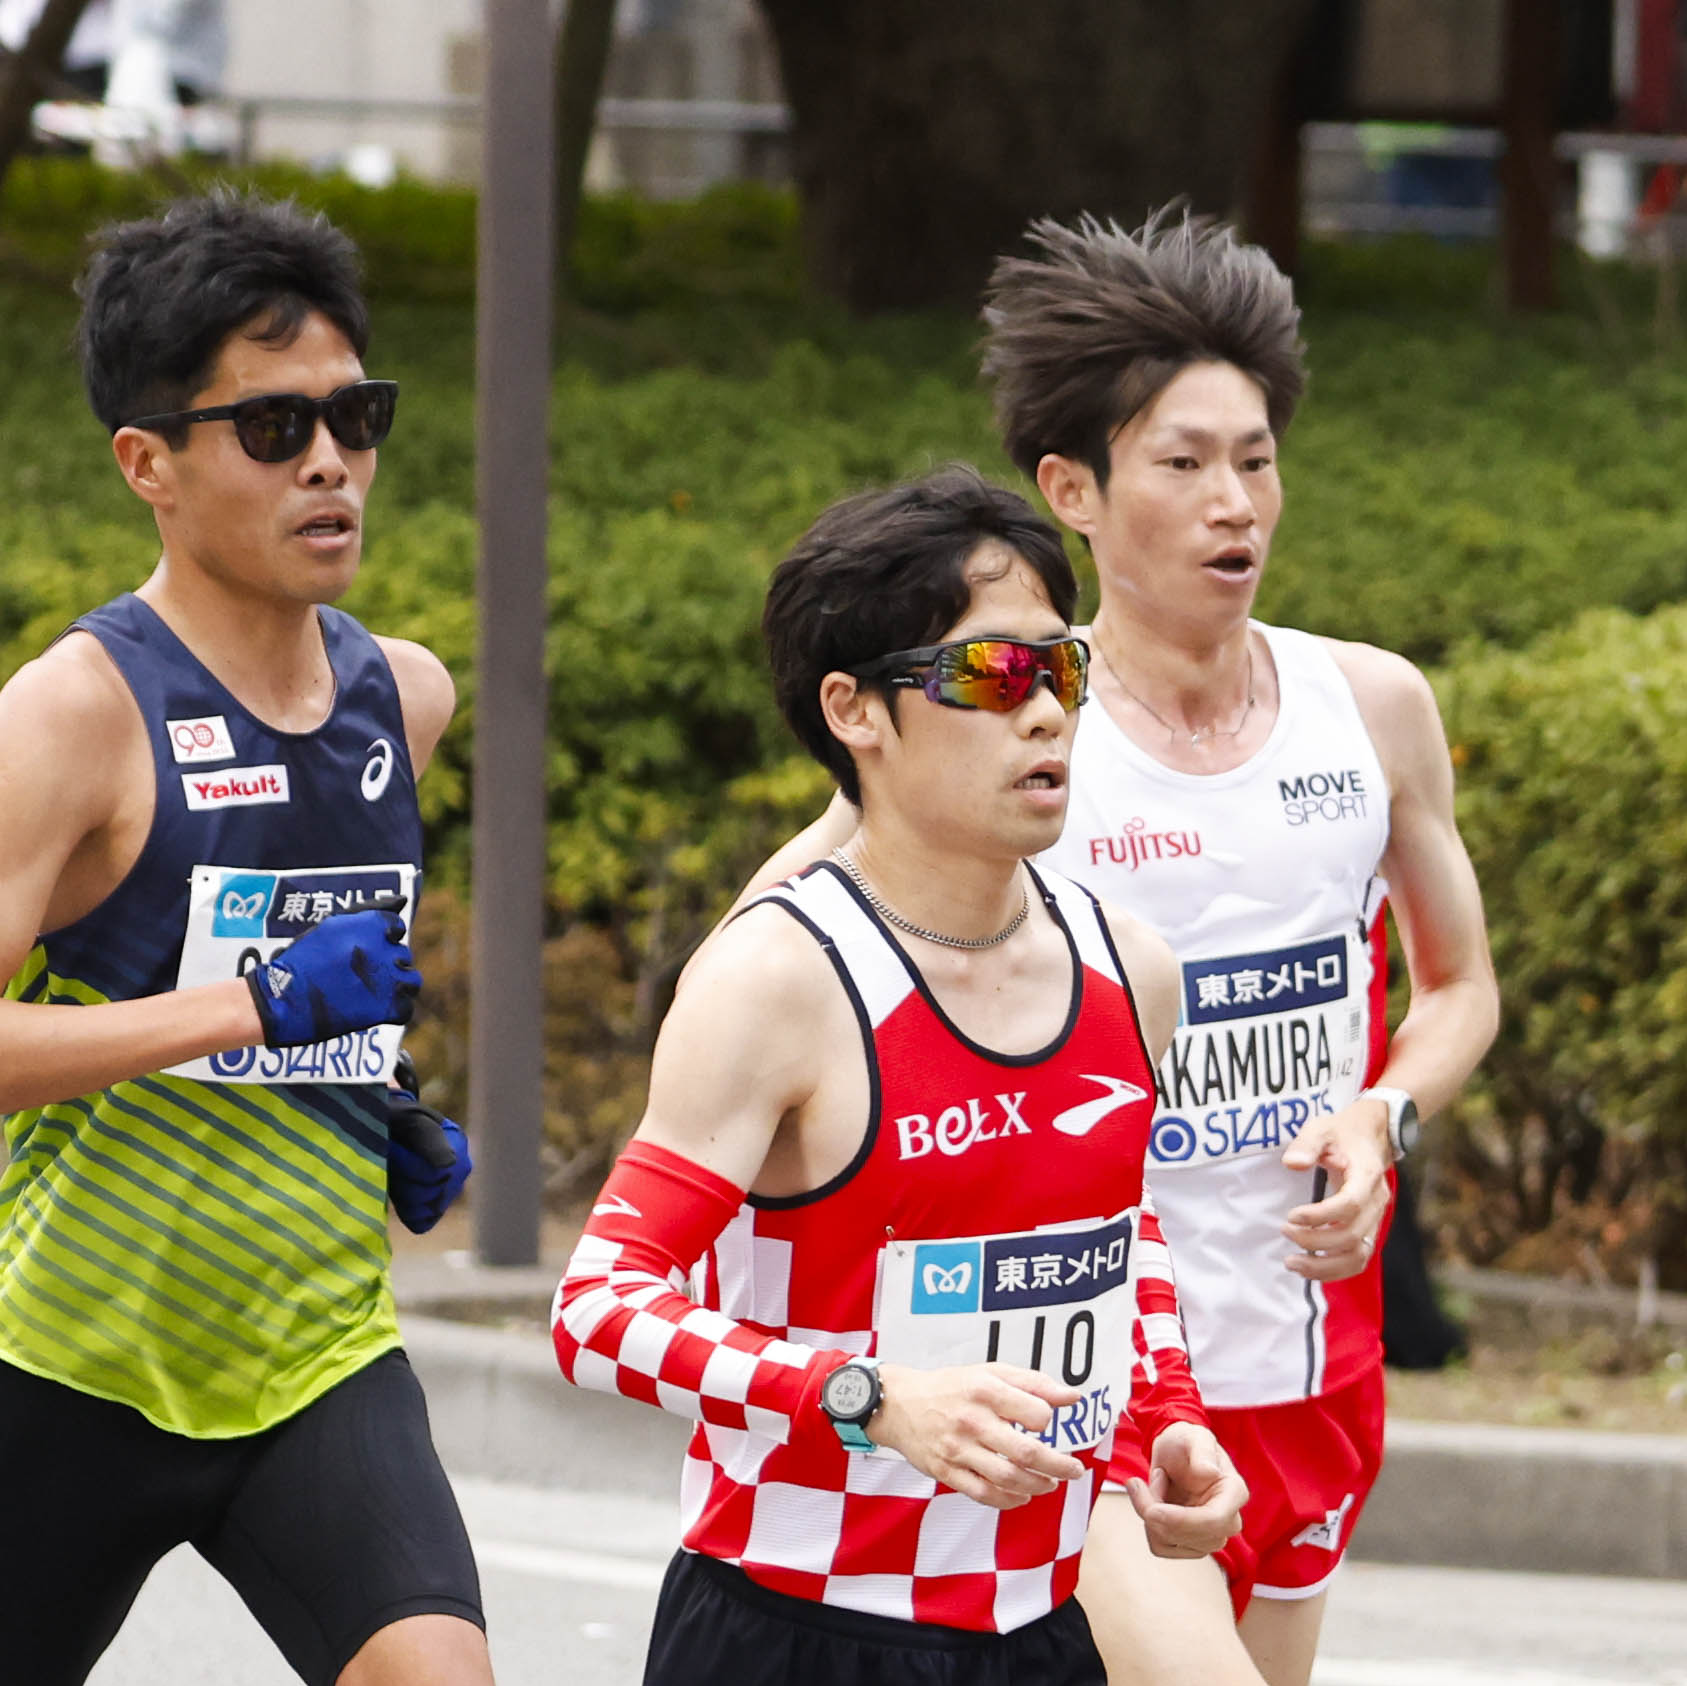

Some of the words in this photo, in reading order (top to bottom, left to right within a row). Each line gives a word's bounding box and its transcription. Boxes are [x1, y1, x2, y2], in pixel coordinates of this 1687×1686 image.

[193, 775, 281, 800] Yakult
[1278, 770, 1365, 801] MOVE
[1285, 794, 1368, 827] SPORT
[1089, 826, 1201, 871] FUJITSU
[278, 889, 394, 923] 東京メ
[1196, 954, 1342, 1009] 東京メトロ
[995, 1236, 1126, 1292] 東京メトロ
